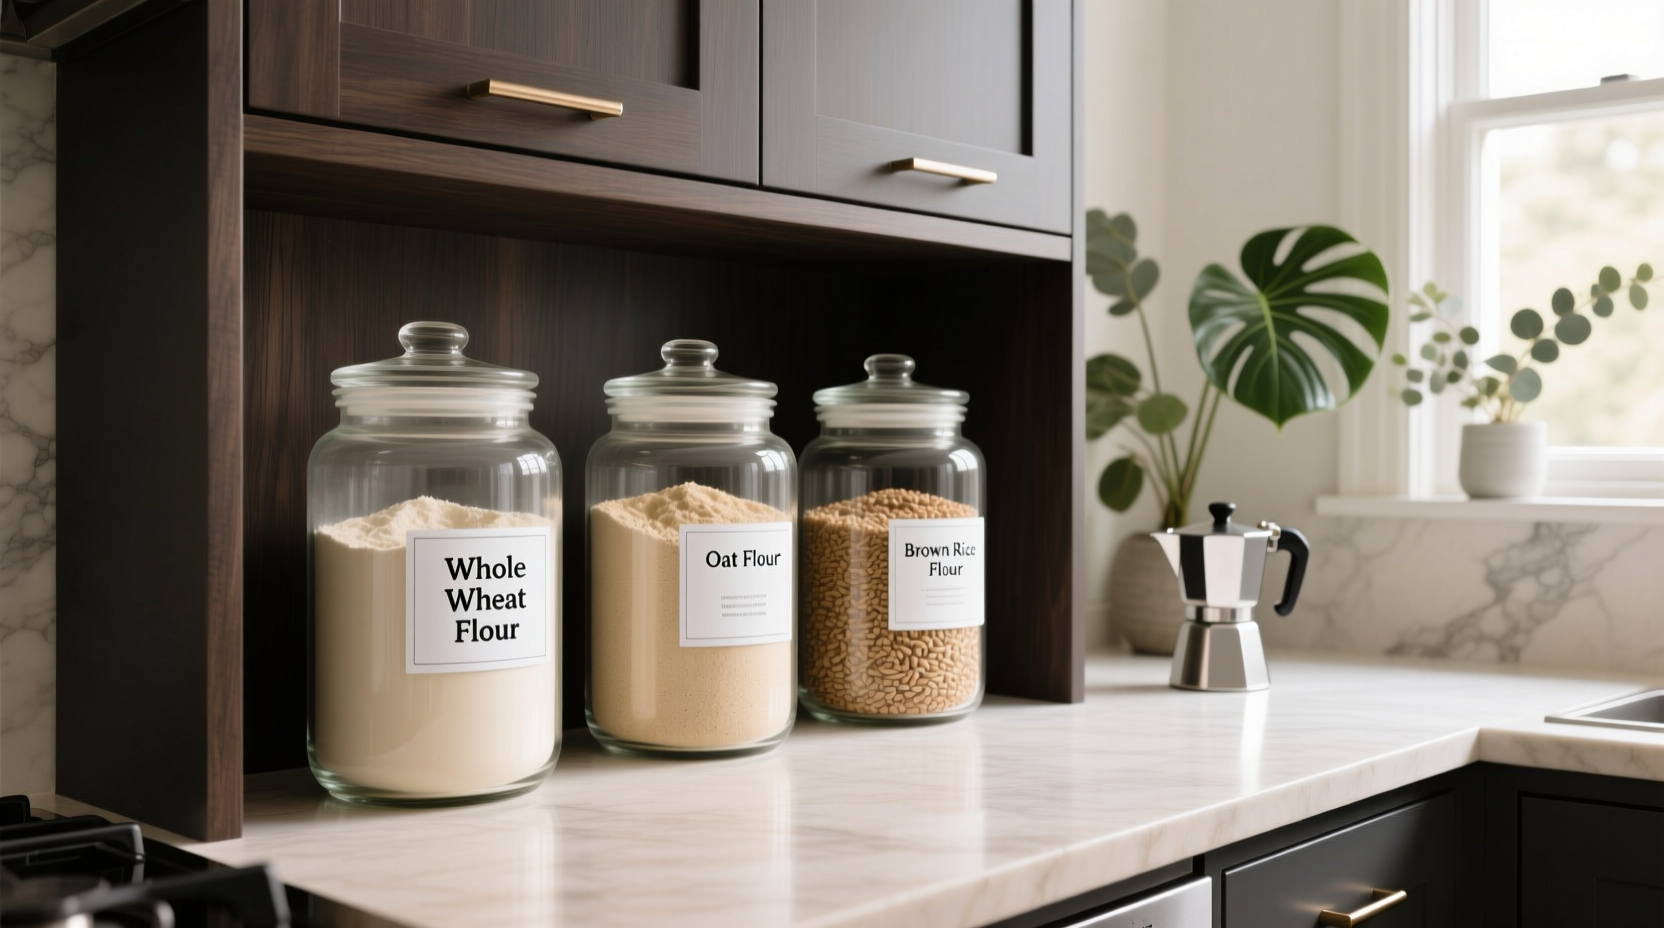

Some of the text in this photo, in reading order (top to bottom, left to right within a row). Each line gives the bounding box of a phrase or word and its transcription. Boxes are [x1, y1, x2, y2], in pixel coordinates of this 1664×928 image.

[705, 549, 781, 568] Oat Flour
[904, 542, 976, 558] Brown Rice
[444, 554, 526, 581] Whole
[929, 561, 963, 576] Flour
[444, 586, 527, 613] Wheat
[454, 618, 520, 643] Flour
